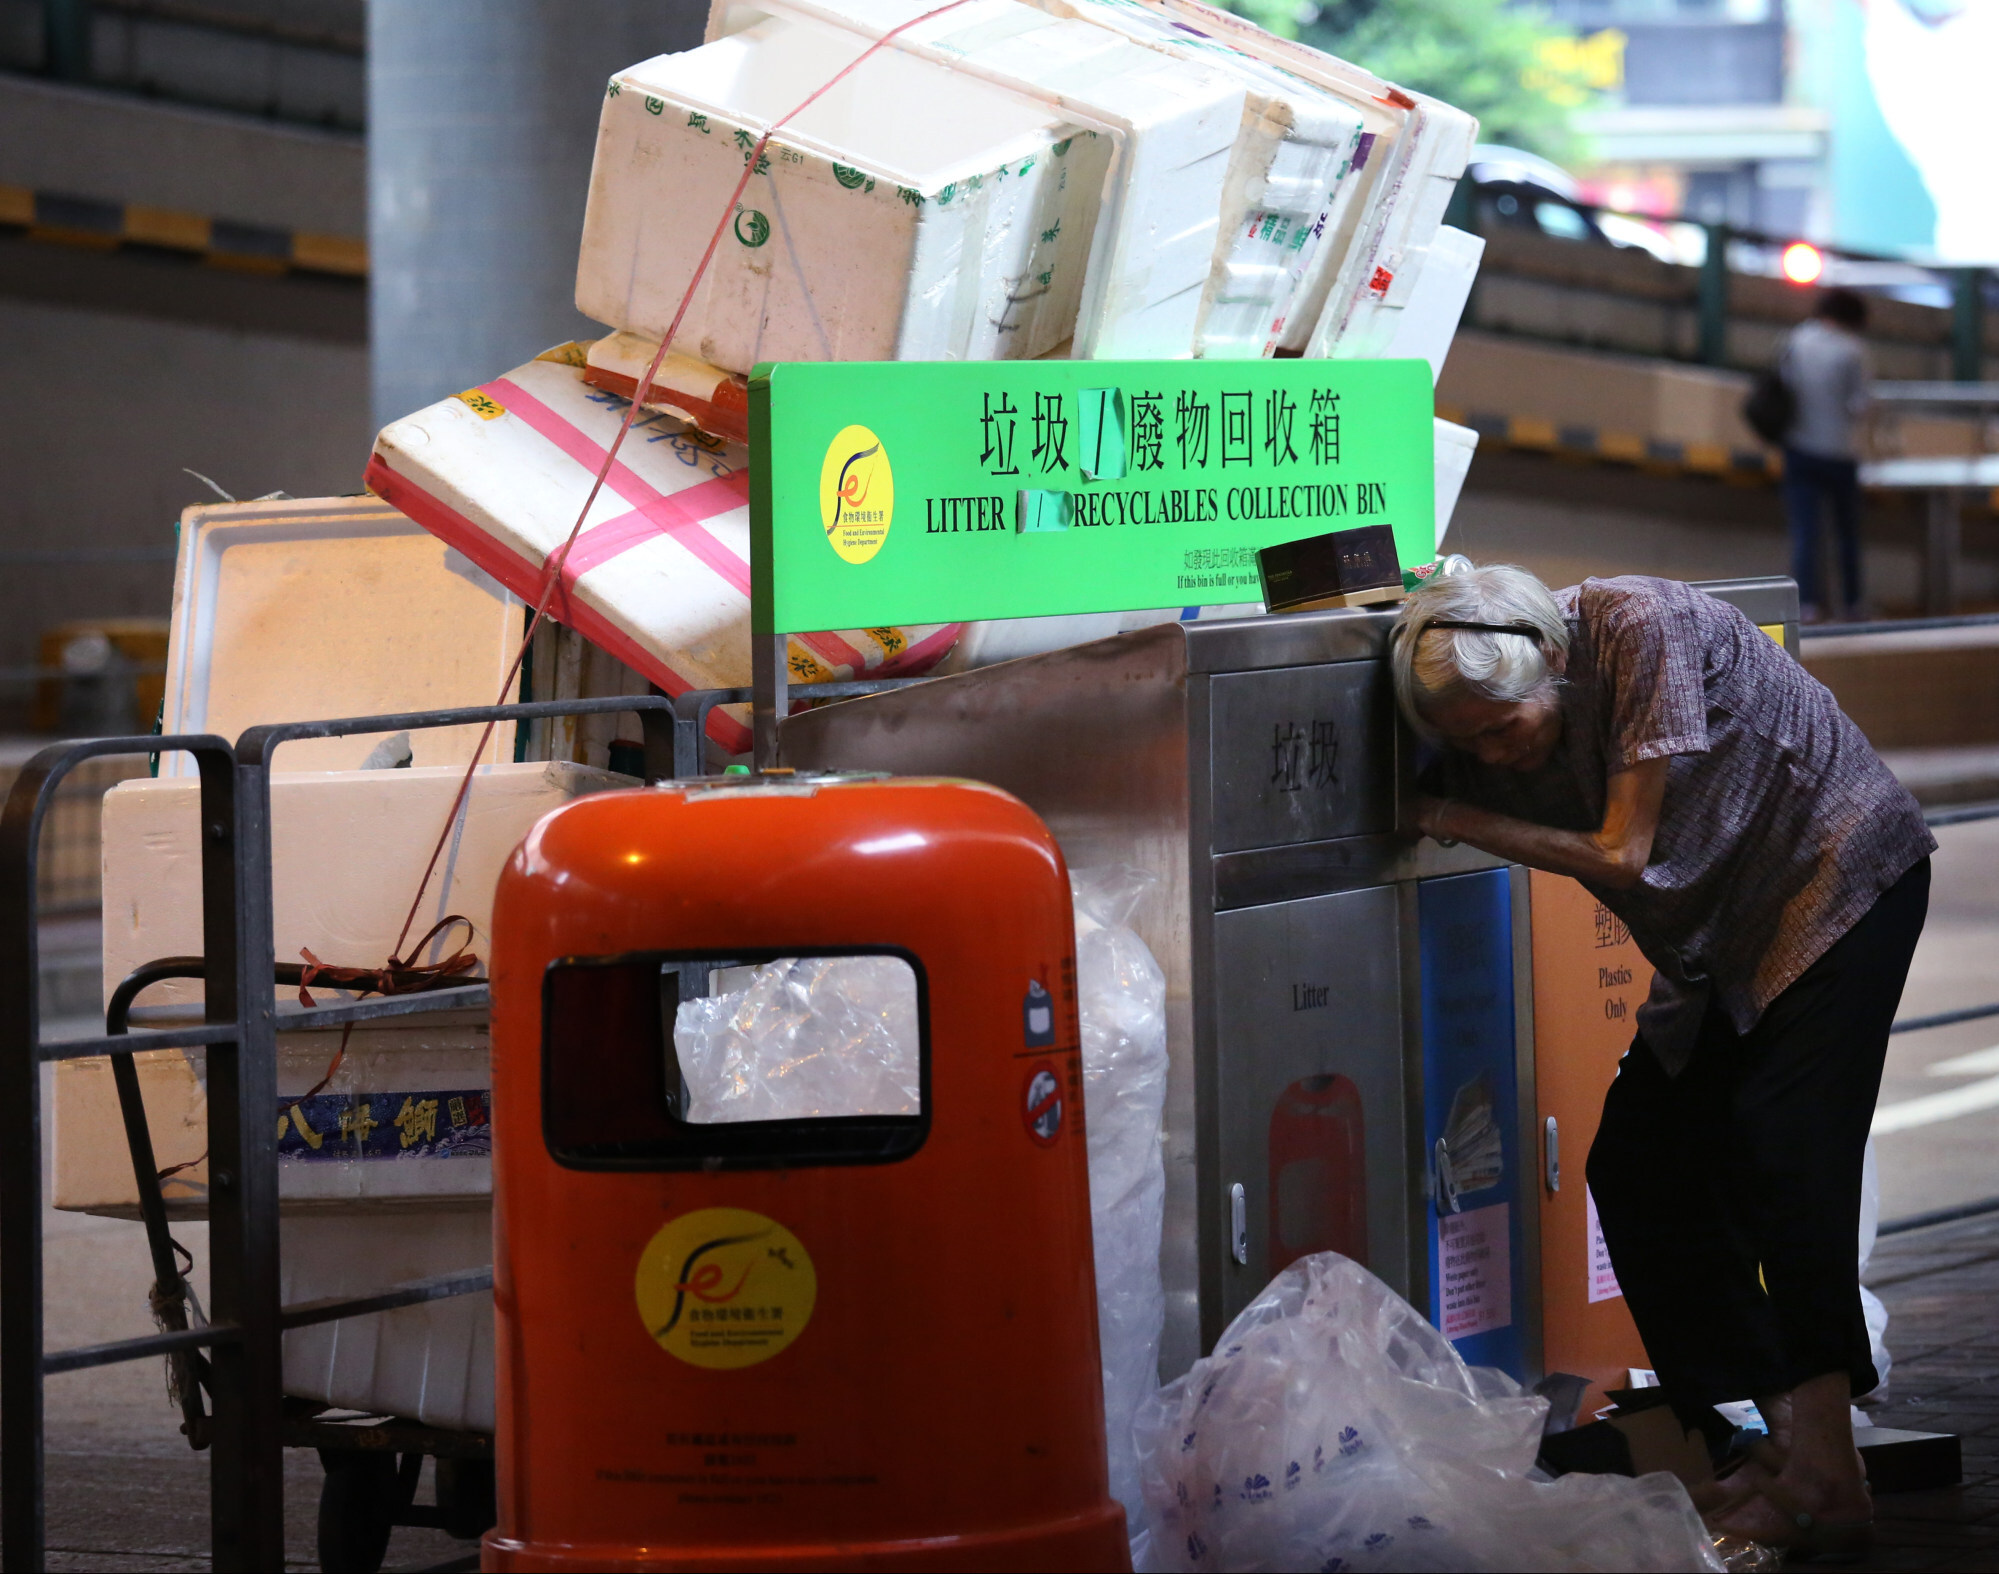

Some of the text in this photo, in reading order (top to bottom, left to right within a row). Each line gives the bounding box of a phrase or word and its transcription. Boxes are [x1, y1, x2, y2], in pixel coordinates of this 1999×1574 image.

[925, 496, 1005, 534] LITTER
[1072, 488, 1218, 528] RECYCLABLES
[1227, 484, 1347, 520] COLLECTION
[1356, 482, 1387, 515] BIN
[1177, 575, 1184, 589] If
[1185, 575, 1196, 588] this
[1198, 574, 1208, 587] bin
[1209, 574, 1215, 587] is
[1216, 573, 1227, 587] full
[1228, 576, 1235, 586] or
[1236, 575, 1247, 589] you
[1271, 719, 1339, 793] 垃圾
[1598, 964, 1632, 989] Plastics
[1292, 983, 1330, 1012] Litter
[1605, 997, 1628, 1023] Only
